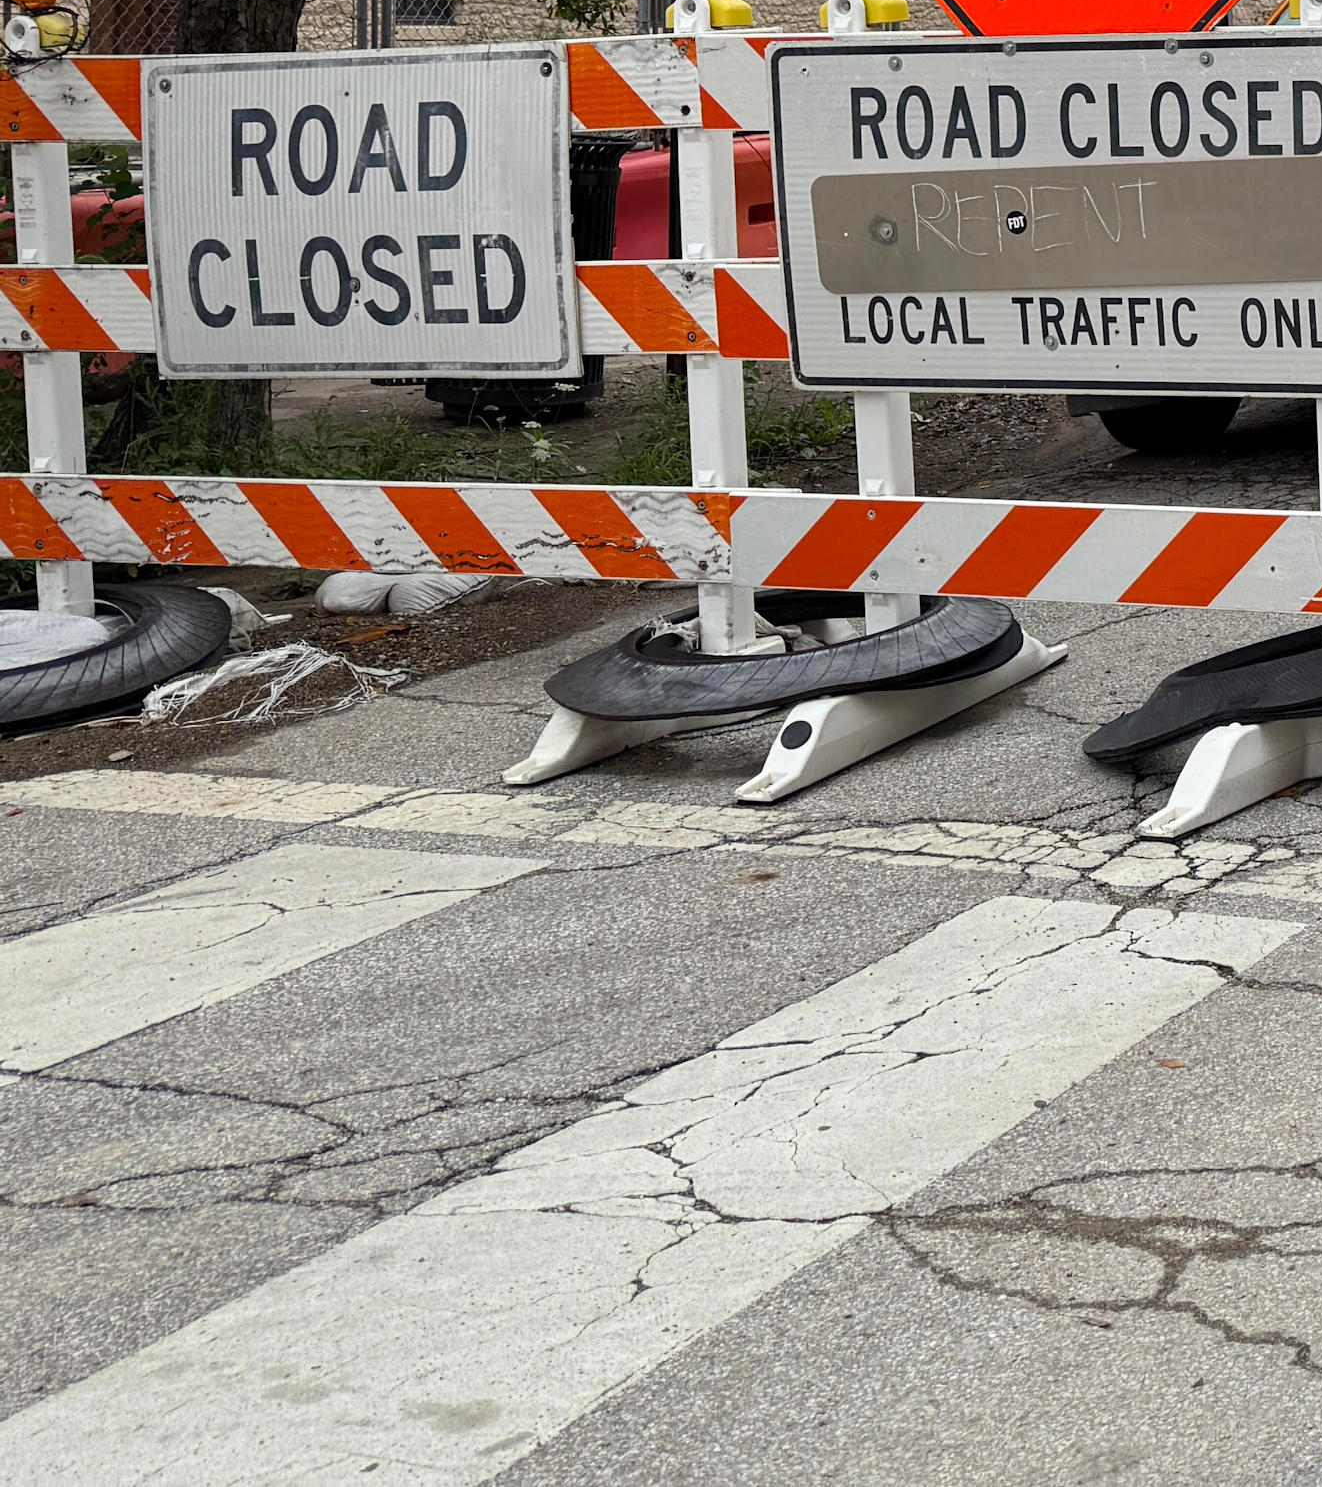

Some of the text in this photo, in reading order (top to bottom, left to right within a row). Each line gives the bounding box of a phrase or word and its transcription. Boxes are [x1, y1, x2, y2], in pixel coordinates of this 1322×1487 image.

[230, 100, 469, 198] ROAD
[851, 84, 1027, 161] ROAD
[911, 177, 1158, 257] REPENT
[1007, 215, 1025, 230] FDT
[188, 233, 527, 329] CLOSED
[840, 296, 986, 346] LOCAL
[1012, 297, 1199, 349] TRAFFIC
